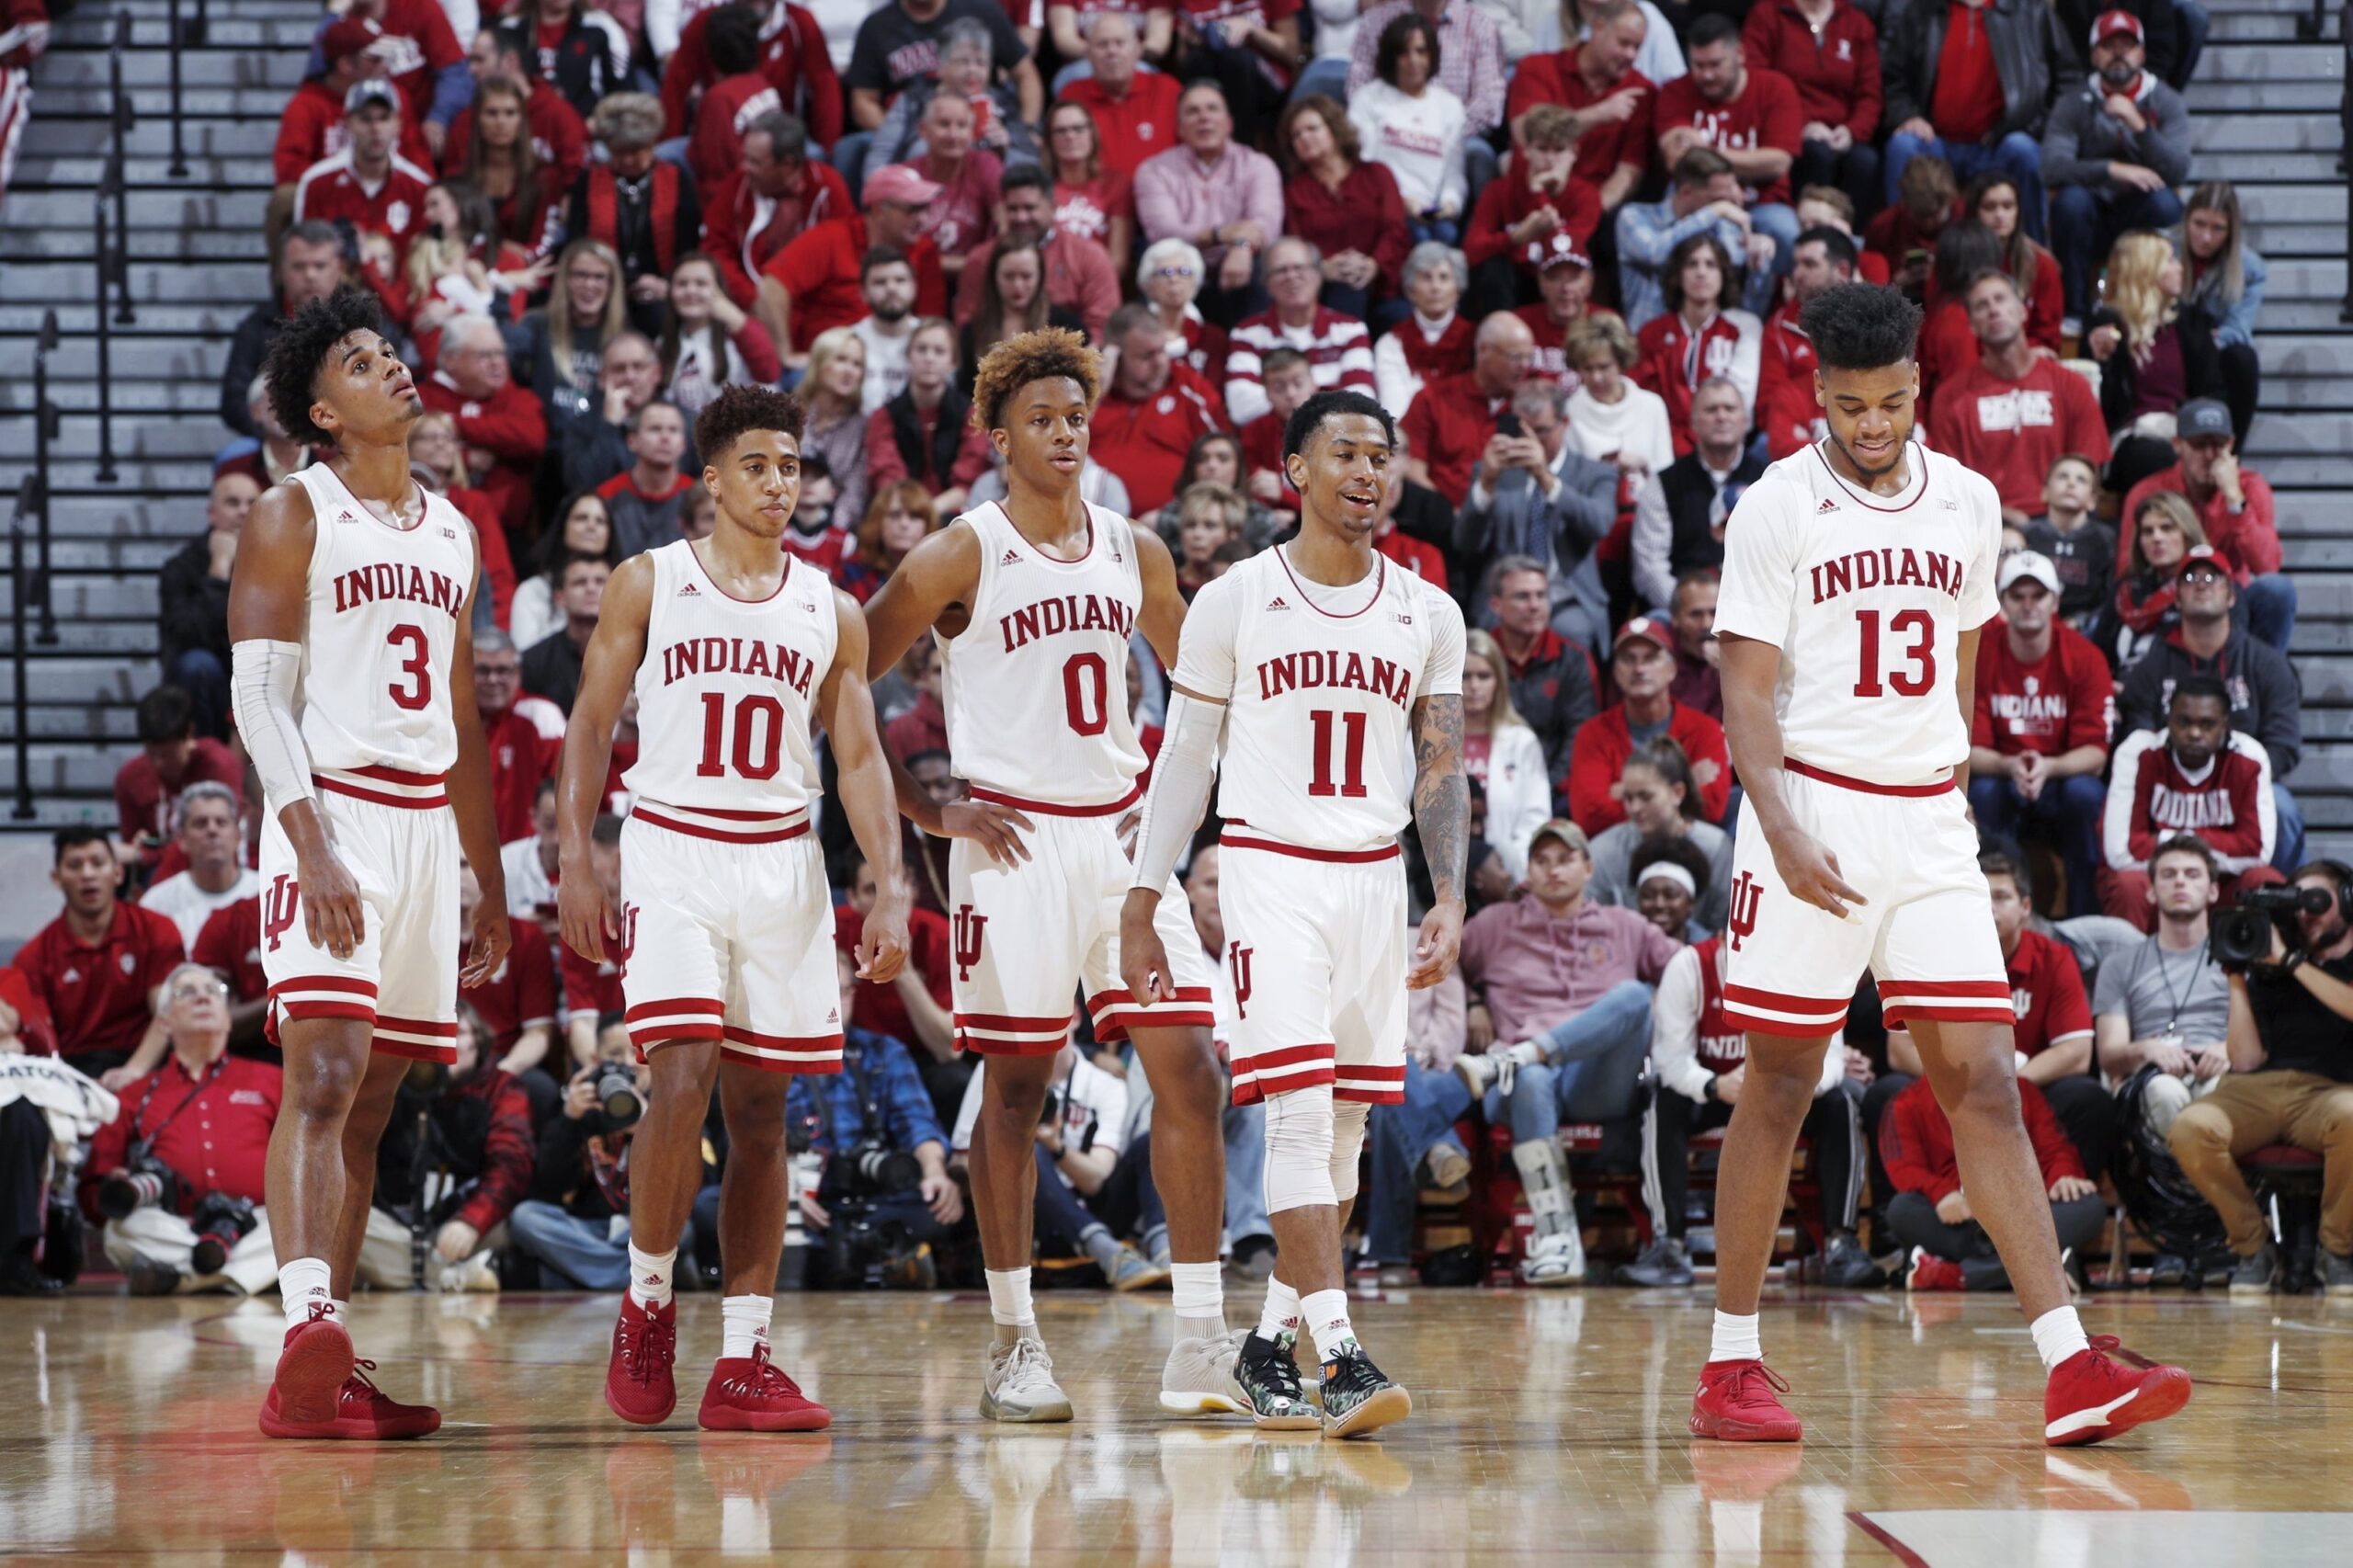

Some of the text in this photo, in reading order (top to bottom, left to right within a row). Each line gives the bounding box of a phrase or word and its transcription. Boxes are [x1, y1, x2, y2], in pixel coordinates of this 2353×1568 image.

[334, 562, 463, 619] INDIANA
[1811, 548, 1963, 606] INDIANA
[1000, 594, 1133, 654] INDIANA
[1853, 609, 1936, 698] 13
[387, 623, 431, 710] 3
[664, 637, 813, 700] INDIANA
[1063, 652, 1108, 737] 0
[1257, 650, 1412, 712] INDIANA
[697, 692, 784, 780] 10
[1309, 710, 1368, 798] 11
